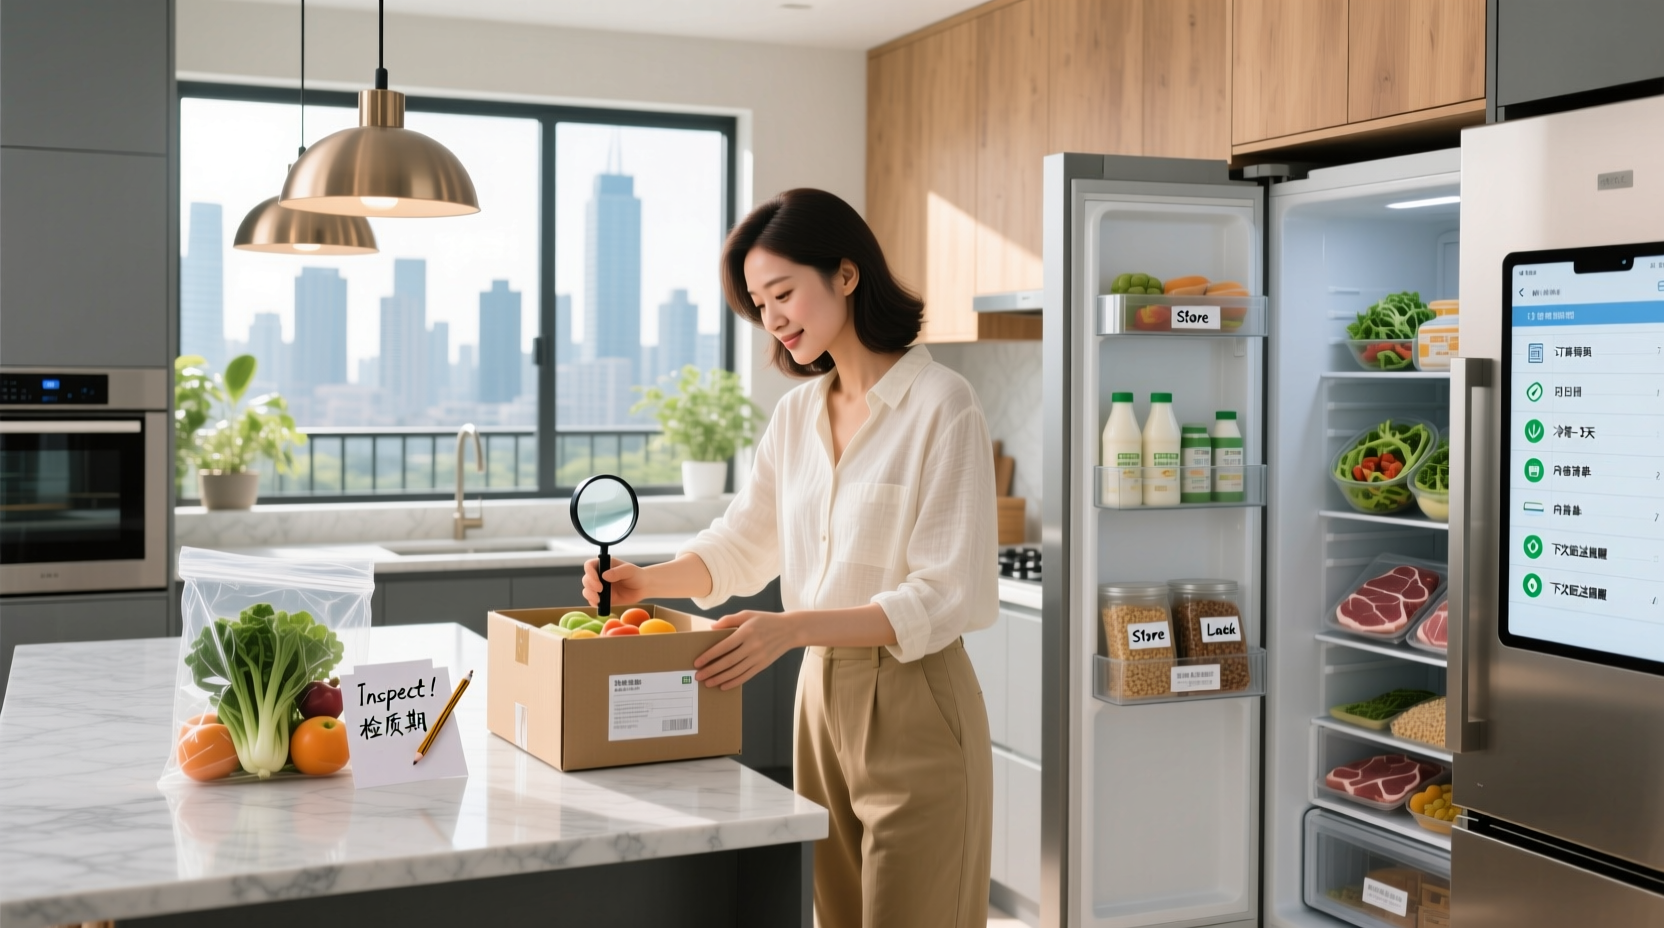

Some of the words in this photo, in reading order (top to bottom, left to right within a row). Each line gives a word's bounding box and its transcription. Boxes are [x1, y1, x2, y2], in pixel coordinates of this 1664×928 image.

[1177, 310, 1209, 324] Store
[358, 677, 436, 711] Inspect!
[359, 708, 428, 740] 检质期
